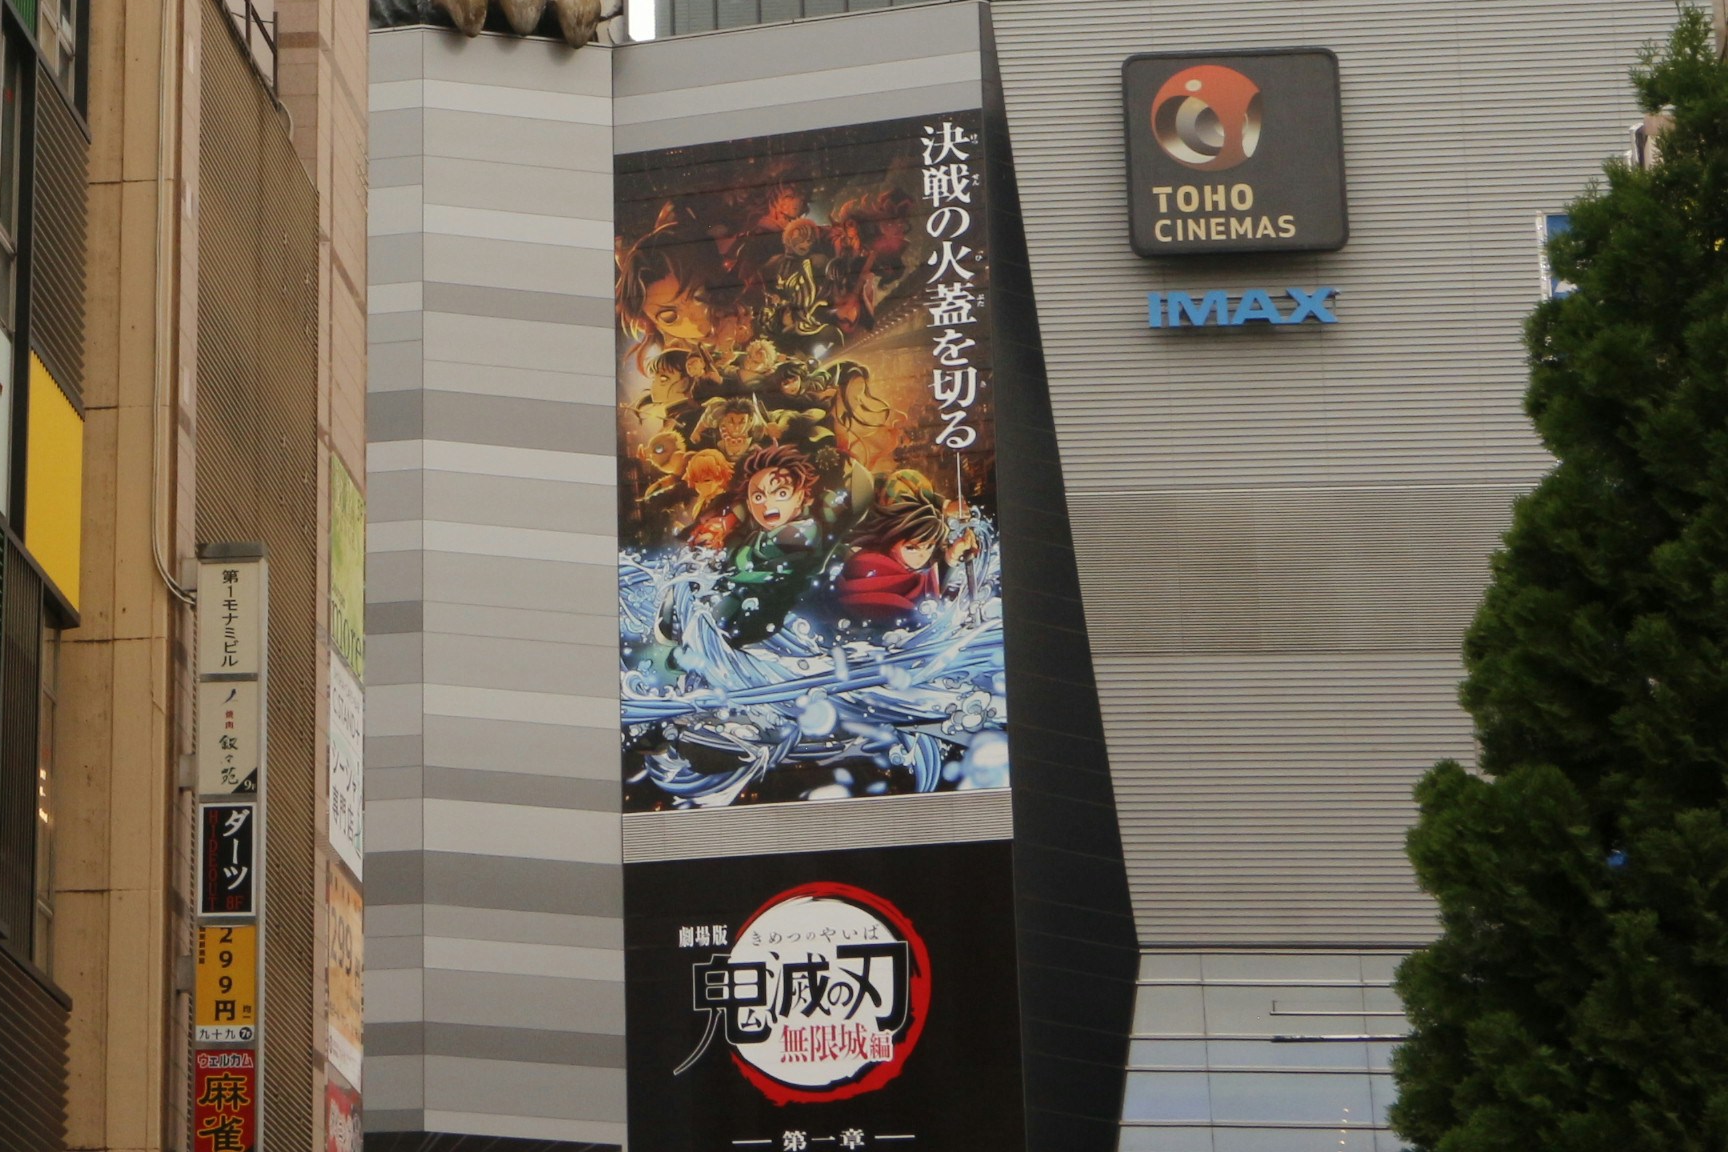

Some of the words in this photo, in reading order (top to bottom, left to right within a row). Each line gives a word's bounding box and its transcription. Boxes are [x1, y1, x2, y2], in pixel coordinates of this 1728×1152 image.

[1152, 183, 1254, 213] TOHO
[1154, 215, 1297, 242] CINEMAS
[921, 121, 978, 449] 決戦の火蓋を切る
[1147, 287, 1338, 328] IMAX
[221, 569, 239, 668] 第1モナミビル
[331, 599, 363, 677] more
[244, 779, 257, 791] 9F
[208, 809, 219, 912] HIDEOUT
[223, 809, 250, 890] ダーツ
[678, 924, 728, 948] 劇場版
[751, 923, 881, 947] きめつのやいば
[674, 941, 909, 1076] 鬼滅の刃
[199, 1029, 235, 1040] 九十九
[780, 1022, 894, 1064] 無限城編
[197, 1052, 254, 1068] ウェルカム
[197, 1072, 250, 1152] 麻雀
[782, 1127, 865, 1151] 第一章
